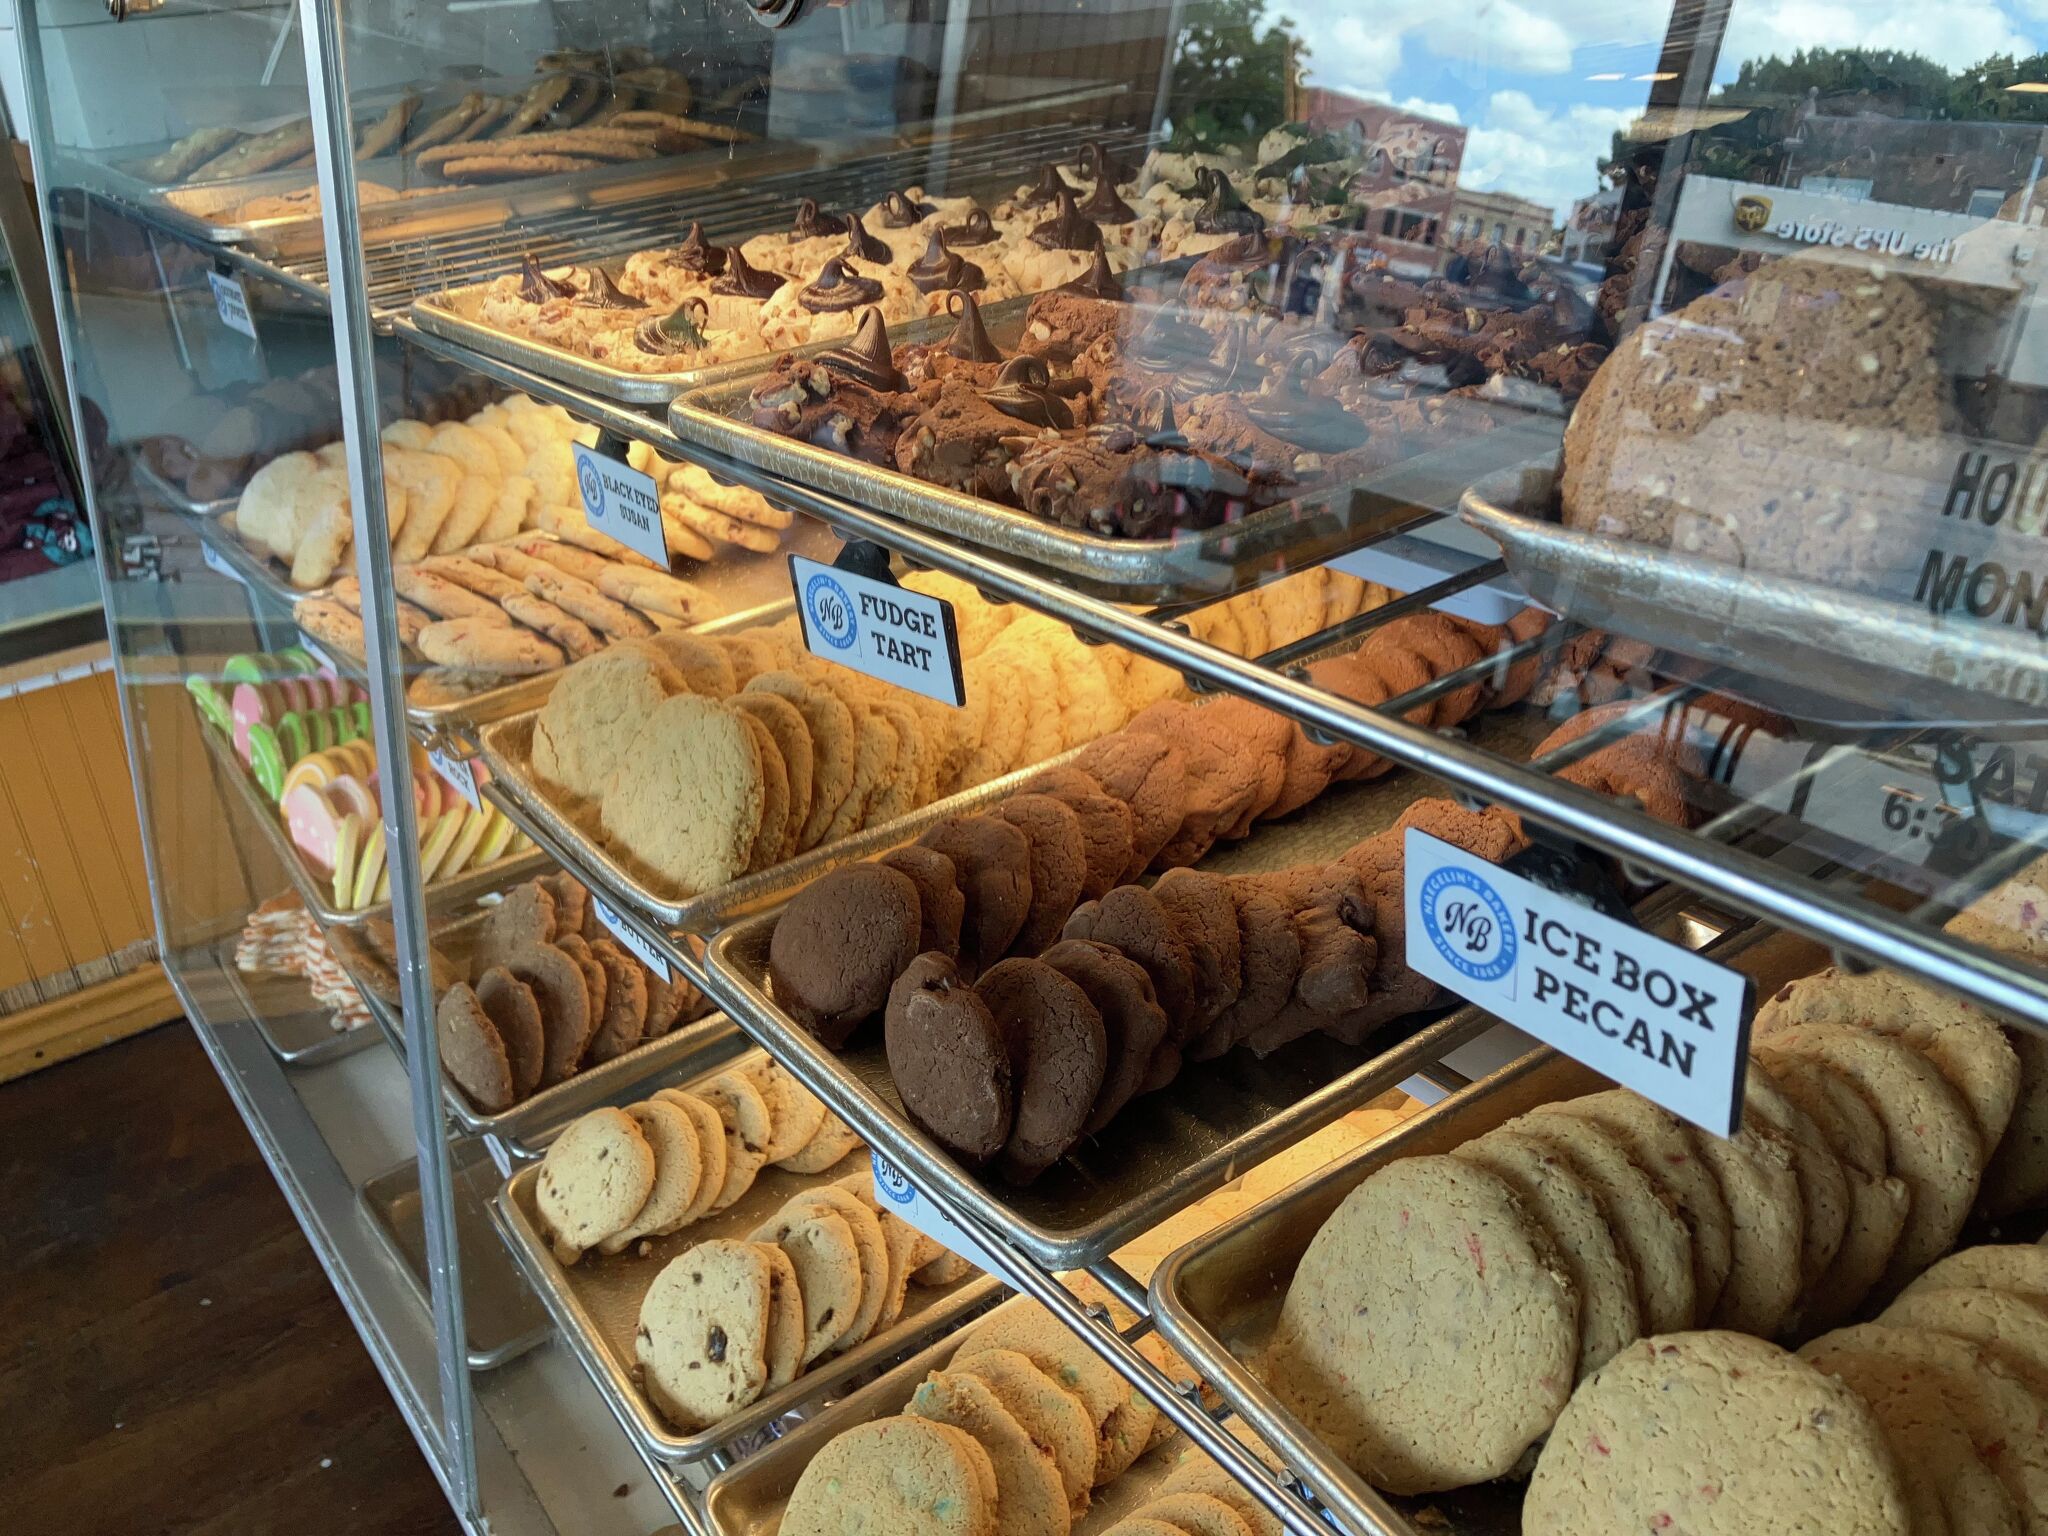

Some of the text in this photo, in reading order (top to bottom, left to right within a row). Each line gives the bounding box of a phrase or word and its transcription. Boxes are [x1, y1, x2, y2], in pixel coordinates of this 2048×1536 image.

[602, 473, 634, 503] BLACK
[634, 487, 659, 515] EYED
[619, 503, 651, 533] SUSAN
[819, 595, 843, 630] NB
[859, 591, 937, 639] FUDGE
[871, 630, 932, 672] TART
[1444, 902, 1492, 951] NB
[1523, 907, 1719, 1032] ICE BOX
[1533, 966, 1697, 1078] PECAN
